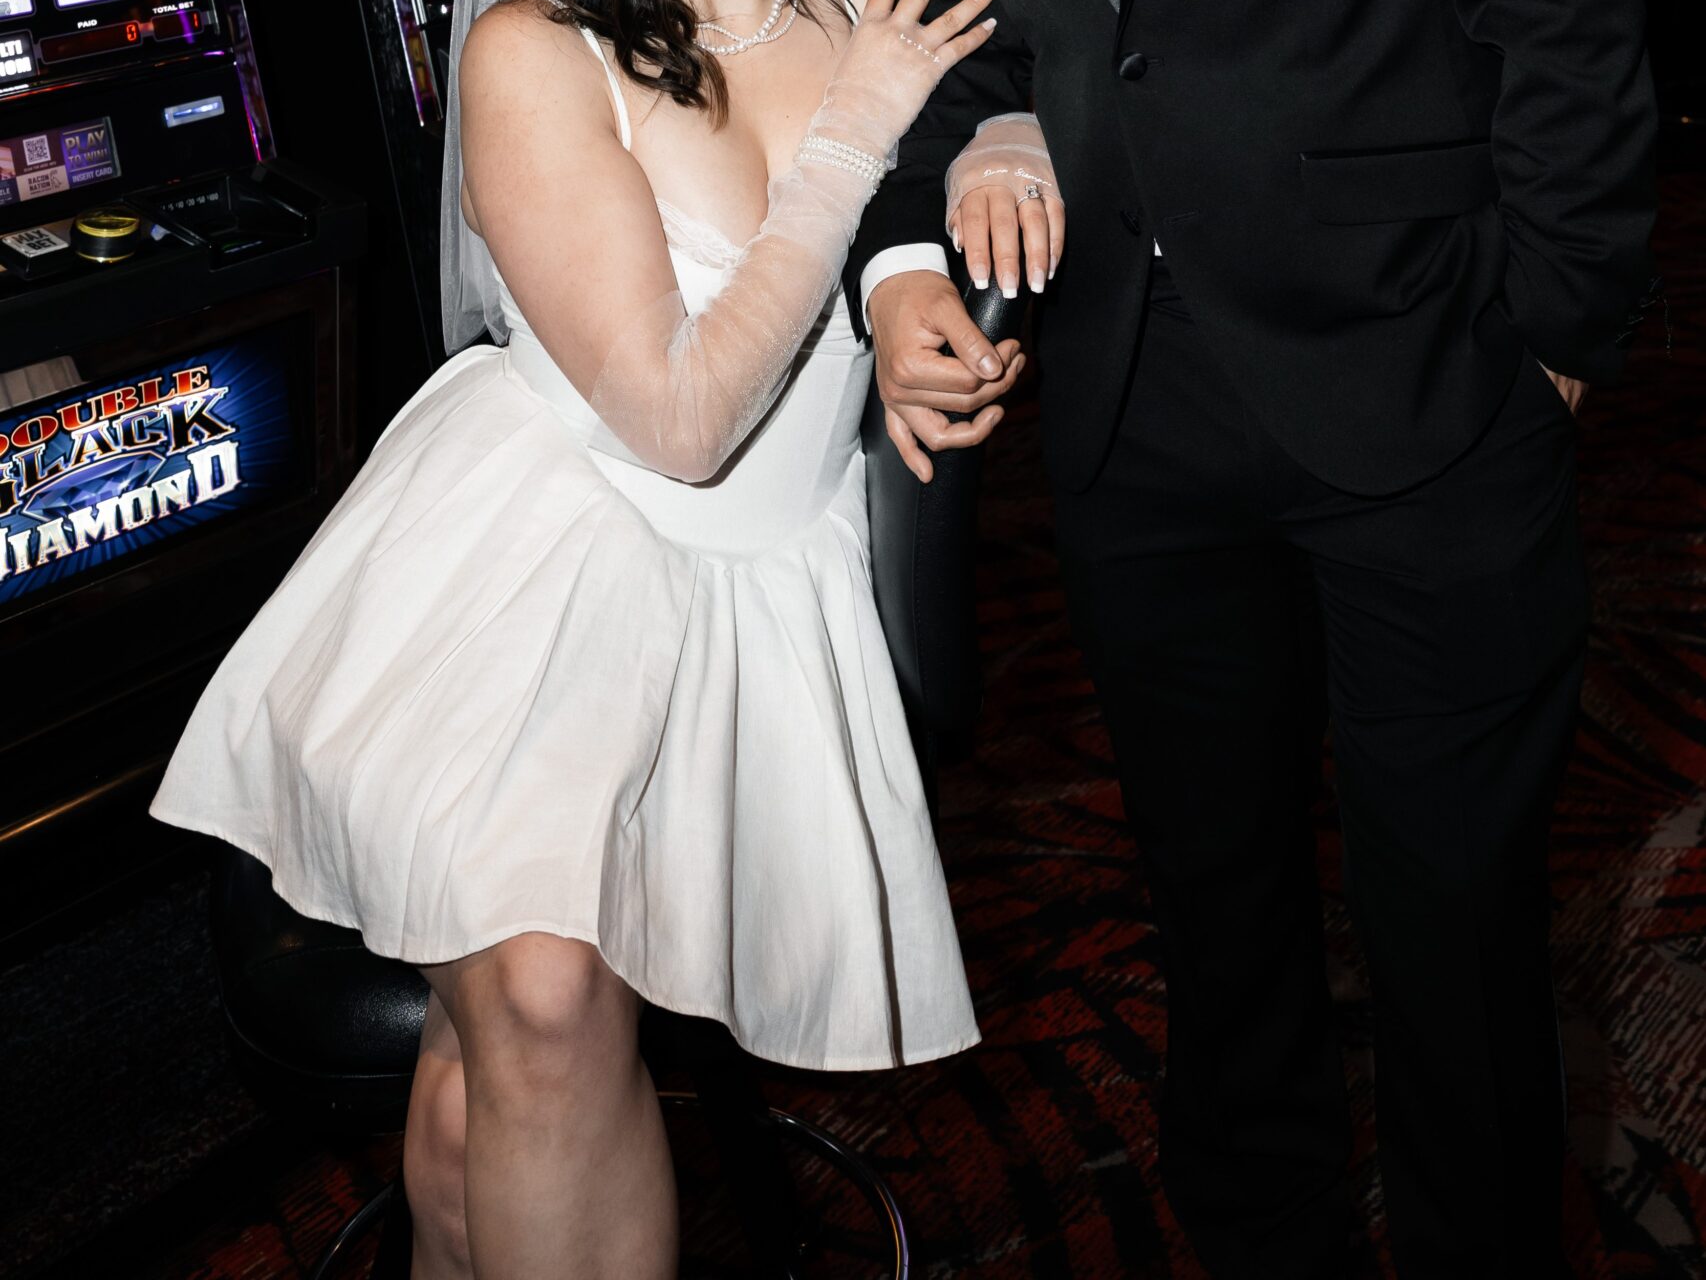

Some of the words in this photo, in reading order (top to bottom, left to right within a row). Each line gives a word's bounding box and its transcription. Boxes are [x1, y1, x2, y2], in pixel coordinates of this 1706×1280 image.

[152, 4, 178, 14] TOTAL
[179, 1, 195, 11] BET
[77, 19, 98, 29] PAID
[126, 24, 137, 42] 0
[65, 129, 105, 152] PLAY
[68, 154, 82, 166] TO
[28, 174, 49, 185] BACON
[72, 172, 95, 183] INSERT
[95, 167, 113, 178] CARD
[29, 181, 51, 192] NATION
[16, 228, 49, 244] MAX
[28, 239, 57, 251] BET
[0, 366, 210, 457] OUBLE
[0, 440, 242, 582] IAMOND
